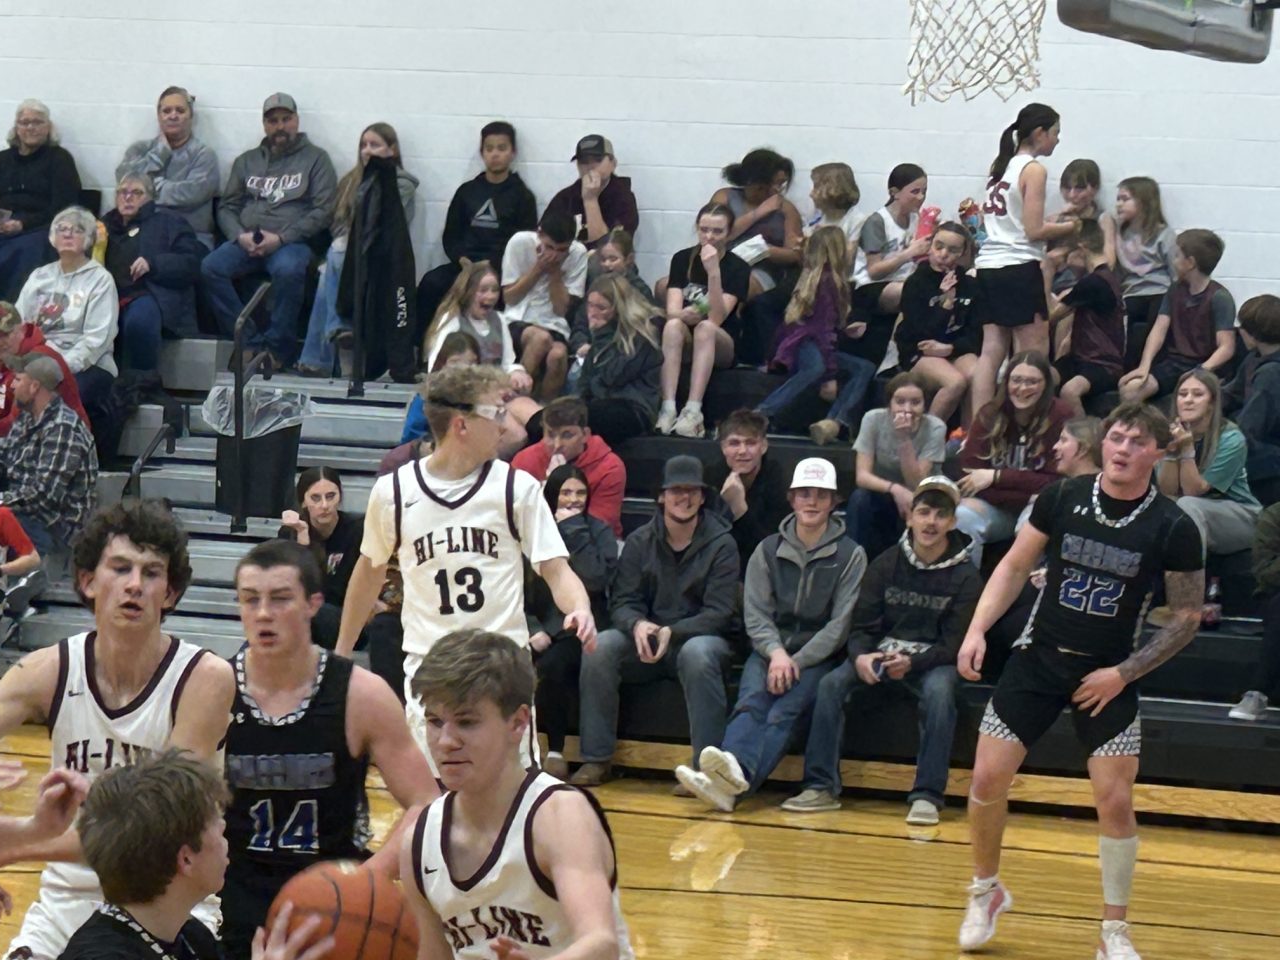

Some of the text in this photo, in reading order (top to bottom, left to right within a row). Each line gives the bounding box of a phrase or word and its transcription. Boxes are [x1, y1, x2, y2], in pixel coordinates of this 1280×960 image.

[413, 526, 499, 566] HI-LINE
[434, 567, 485, 615] 13
[1059, 567, 1126, 617] 22
[246, 798, 320, 855] 14
